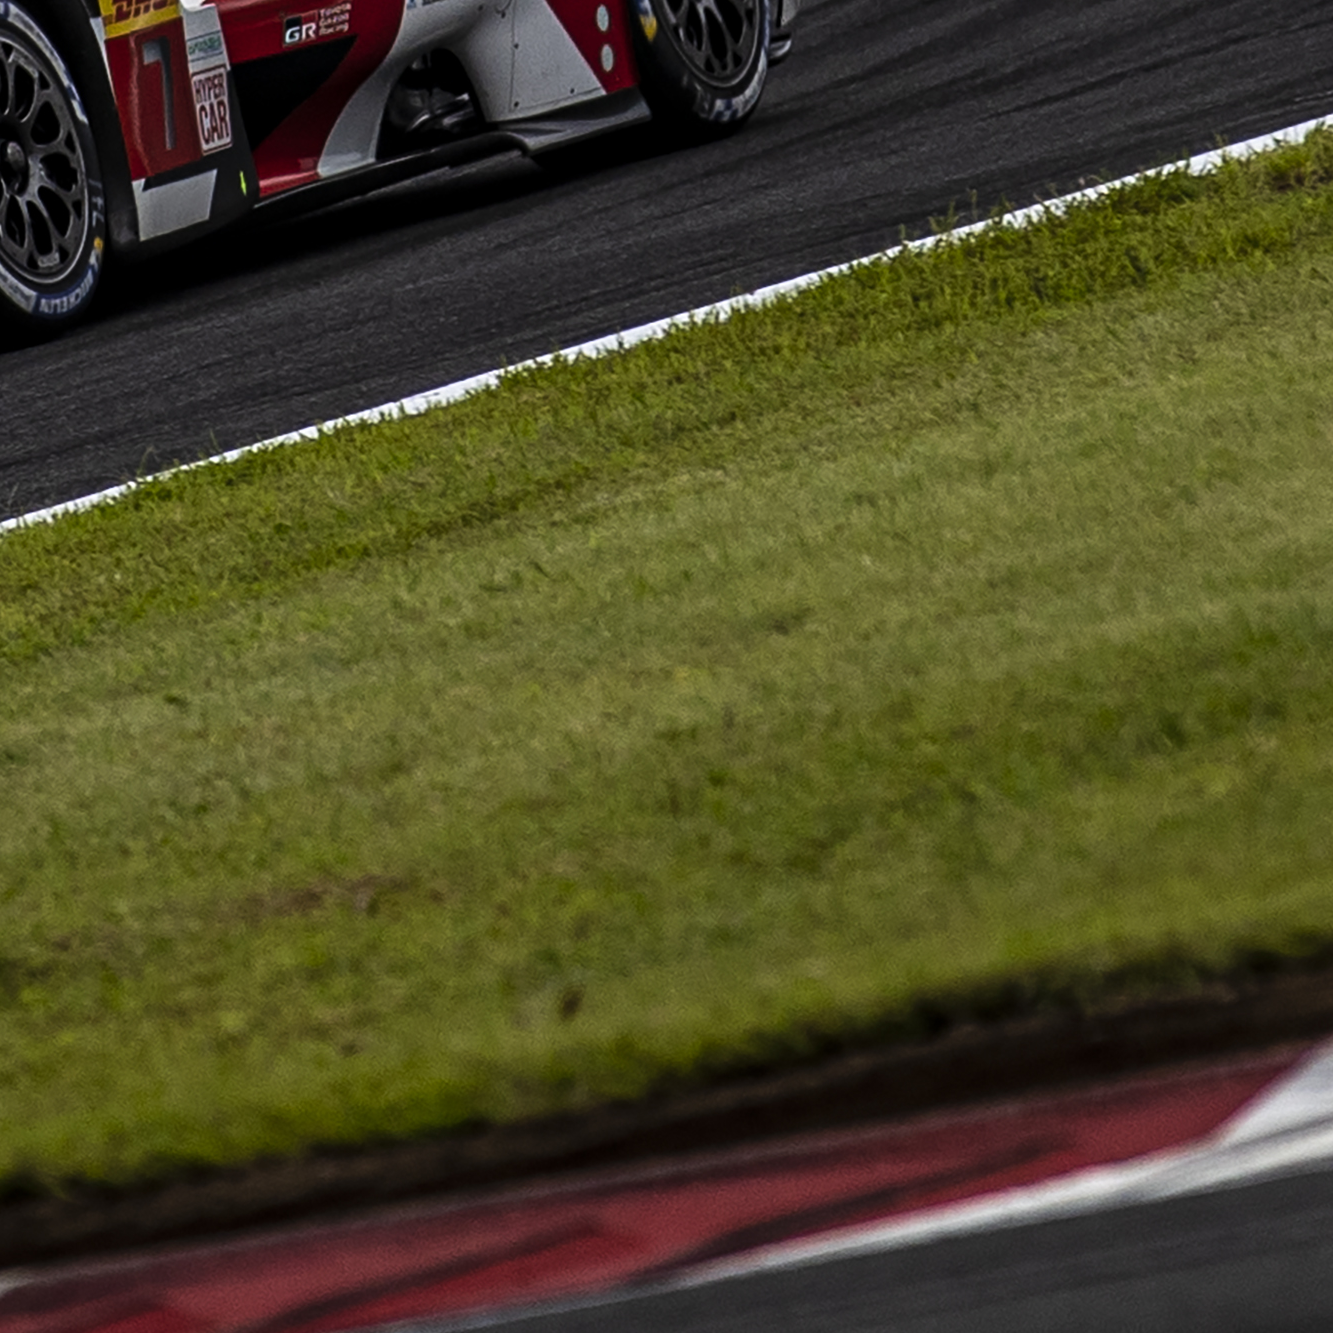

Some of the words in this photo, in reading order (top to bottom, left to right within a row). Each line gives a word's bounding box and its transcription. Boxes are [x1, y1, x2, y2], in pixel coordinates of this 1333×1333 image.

[285, 21, 317, 43] GR
[193, 72, 226, 104] HYPER
[198, 98, 230, 146] CAR
